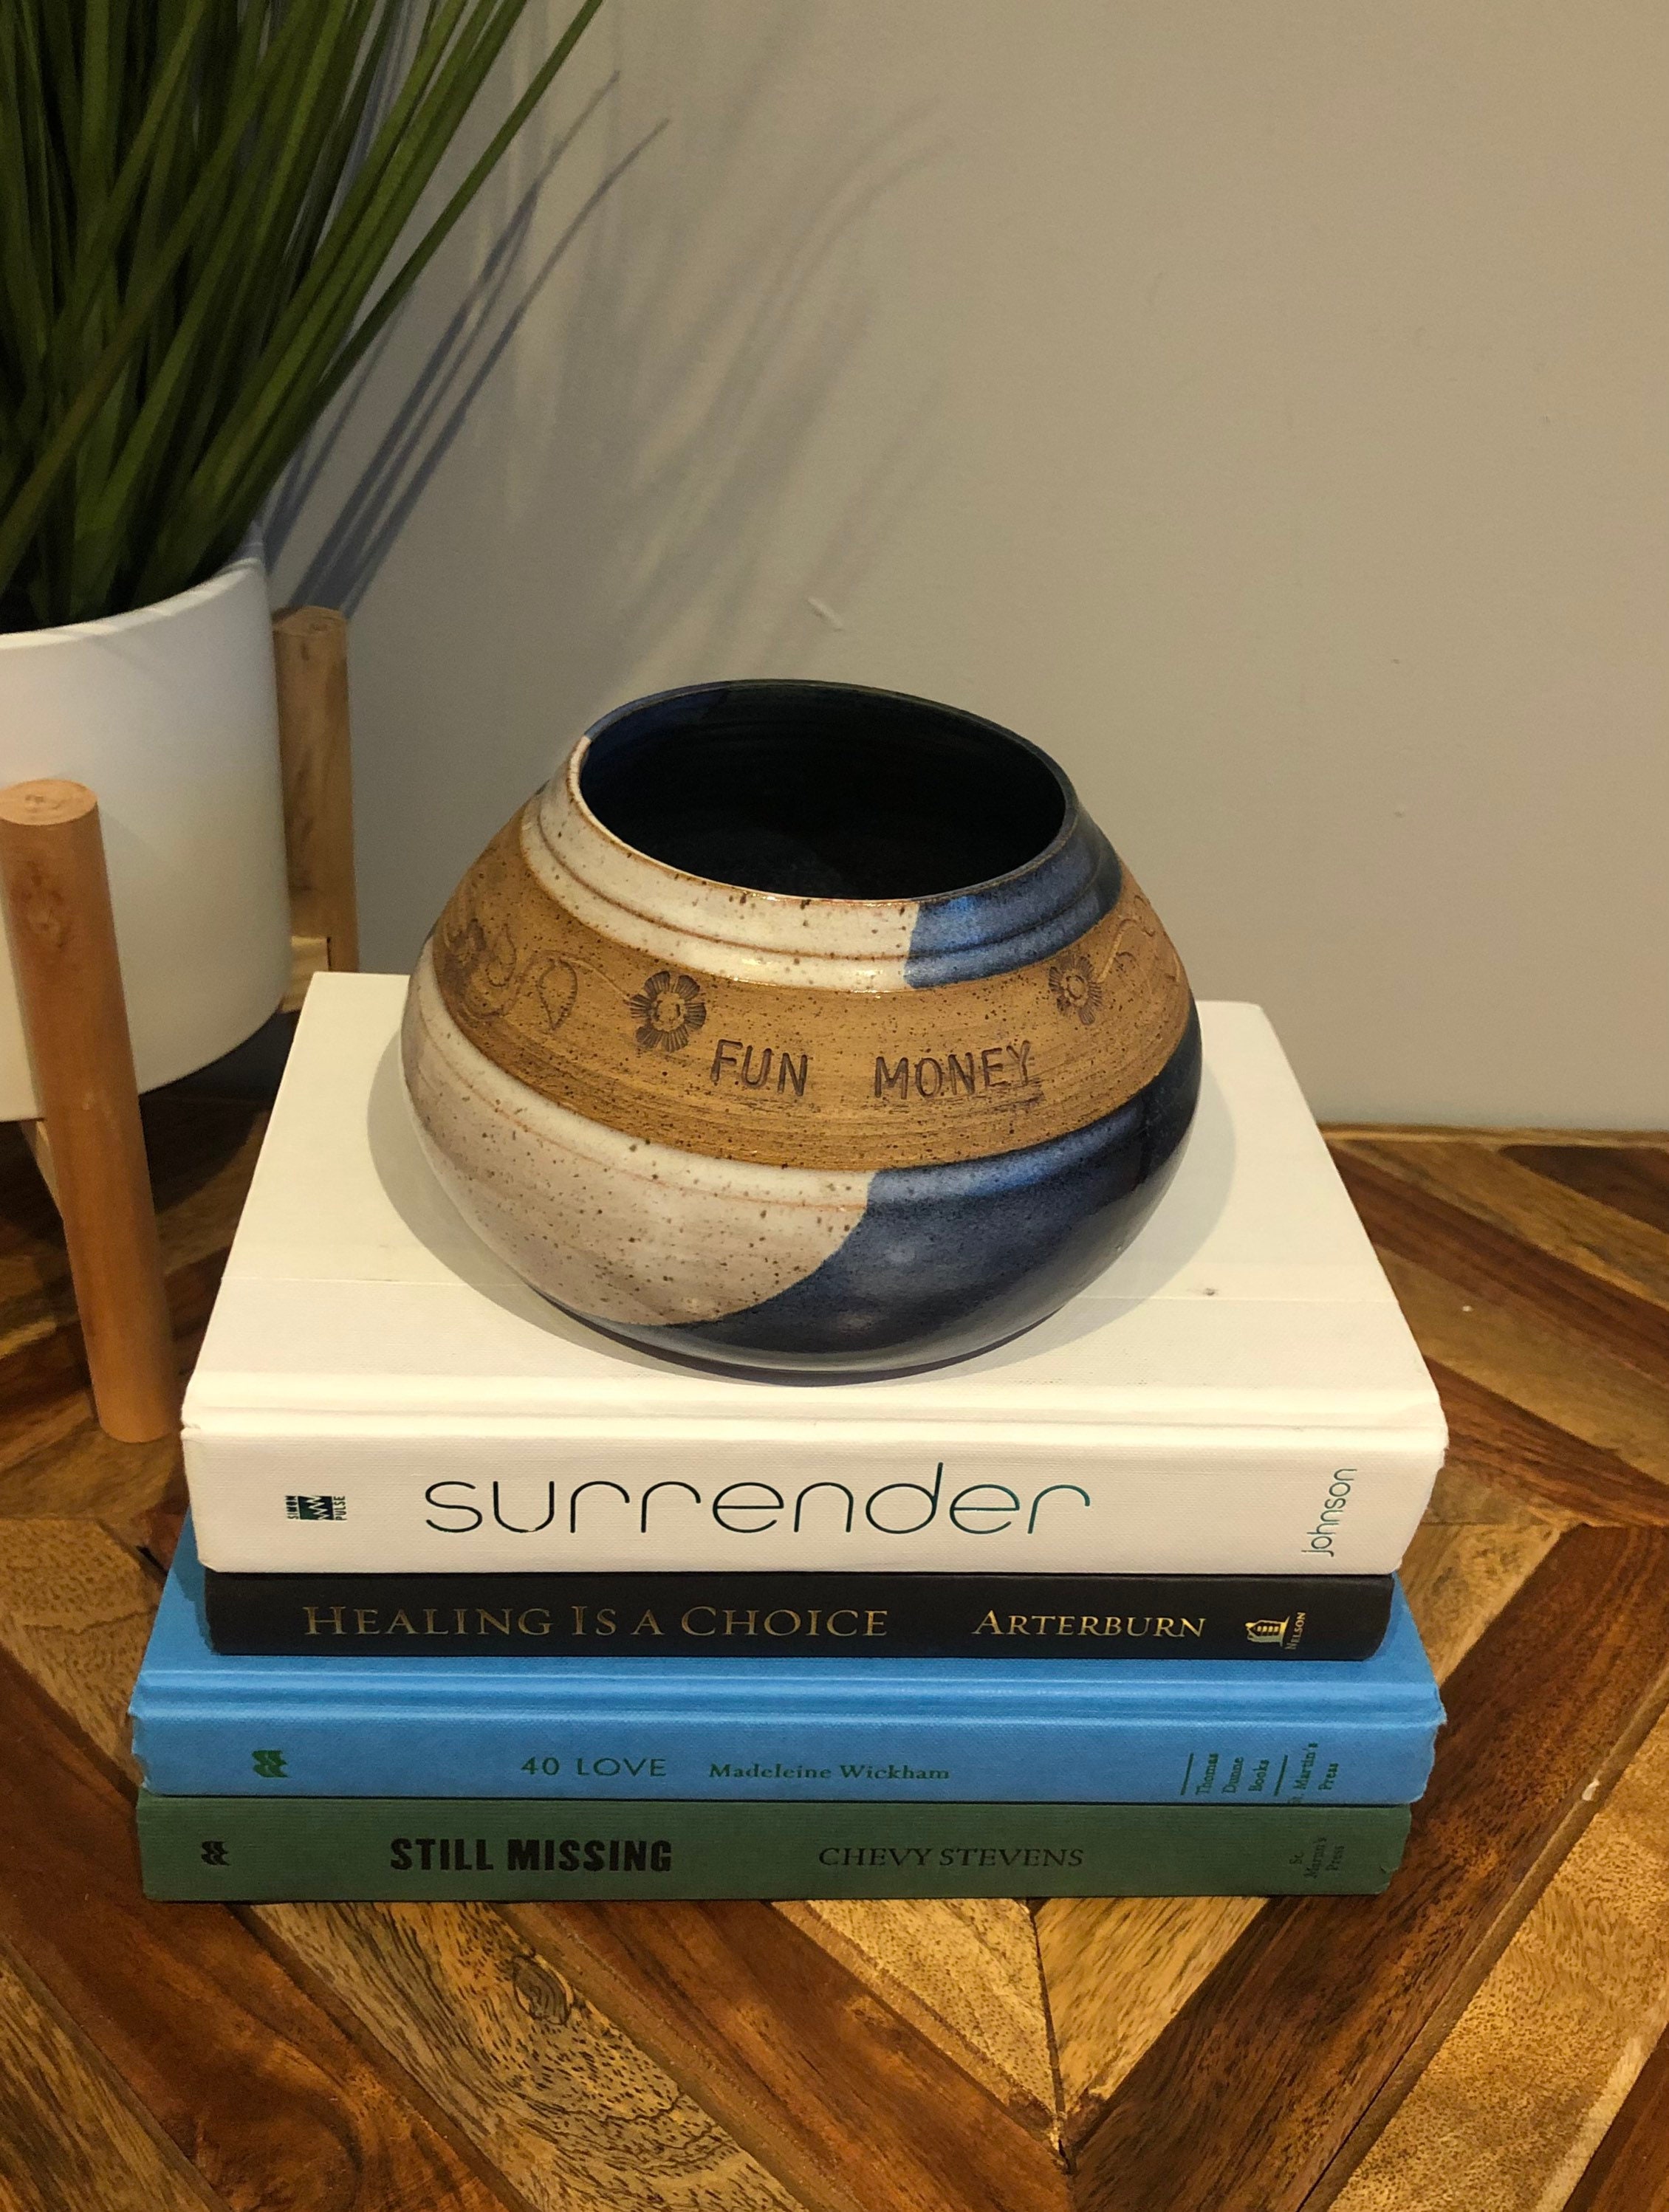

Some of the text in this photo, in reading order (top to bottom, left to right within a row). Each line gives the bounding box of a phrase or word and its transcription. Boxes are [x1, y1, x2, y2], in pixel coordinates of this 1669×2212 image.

[710, 1039, 1031, 1100] FUN MONEY
[333, 1496, 347, 1521] PULSE
[425, 1462, 1091, 1534] surrender
[1301, 1468, 1357, 1557] Johnson
[304, 1605, 553, 1637] HEALING
[631, 1609, 665, 1635] A
[681, 1605, 888, 1638] CHOICE
[971, 1610, 1207, 1638] ARTERBURN
[1285, 1612, 1306, 1650] NELSON
[521, 1757, 668, 1777] 40 LOVE
[709, 1763, 950, 1780] Madeleine Wickham
[1195, 1753, 1219, 1795] Thomas
[1221, 1756, 1244, 1793] Dunne
[1248, 1759, 1270, 1791] Books
[1293, 1742, 1318, 1790] Martin's
[1318, 1763, 1340, 1790] Press
[391, 1838, 672, 1872] STILL MISSING
[818, 1847, 1084, 1866] CHEVY STEVENS
